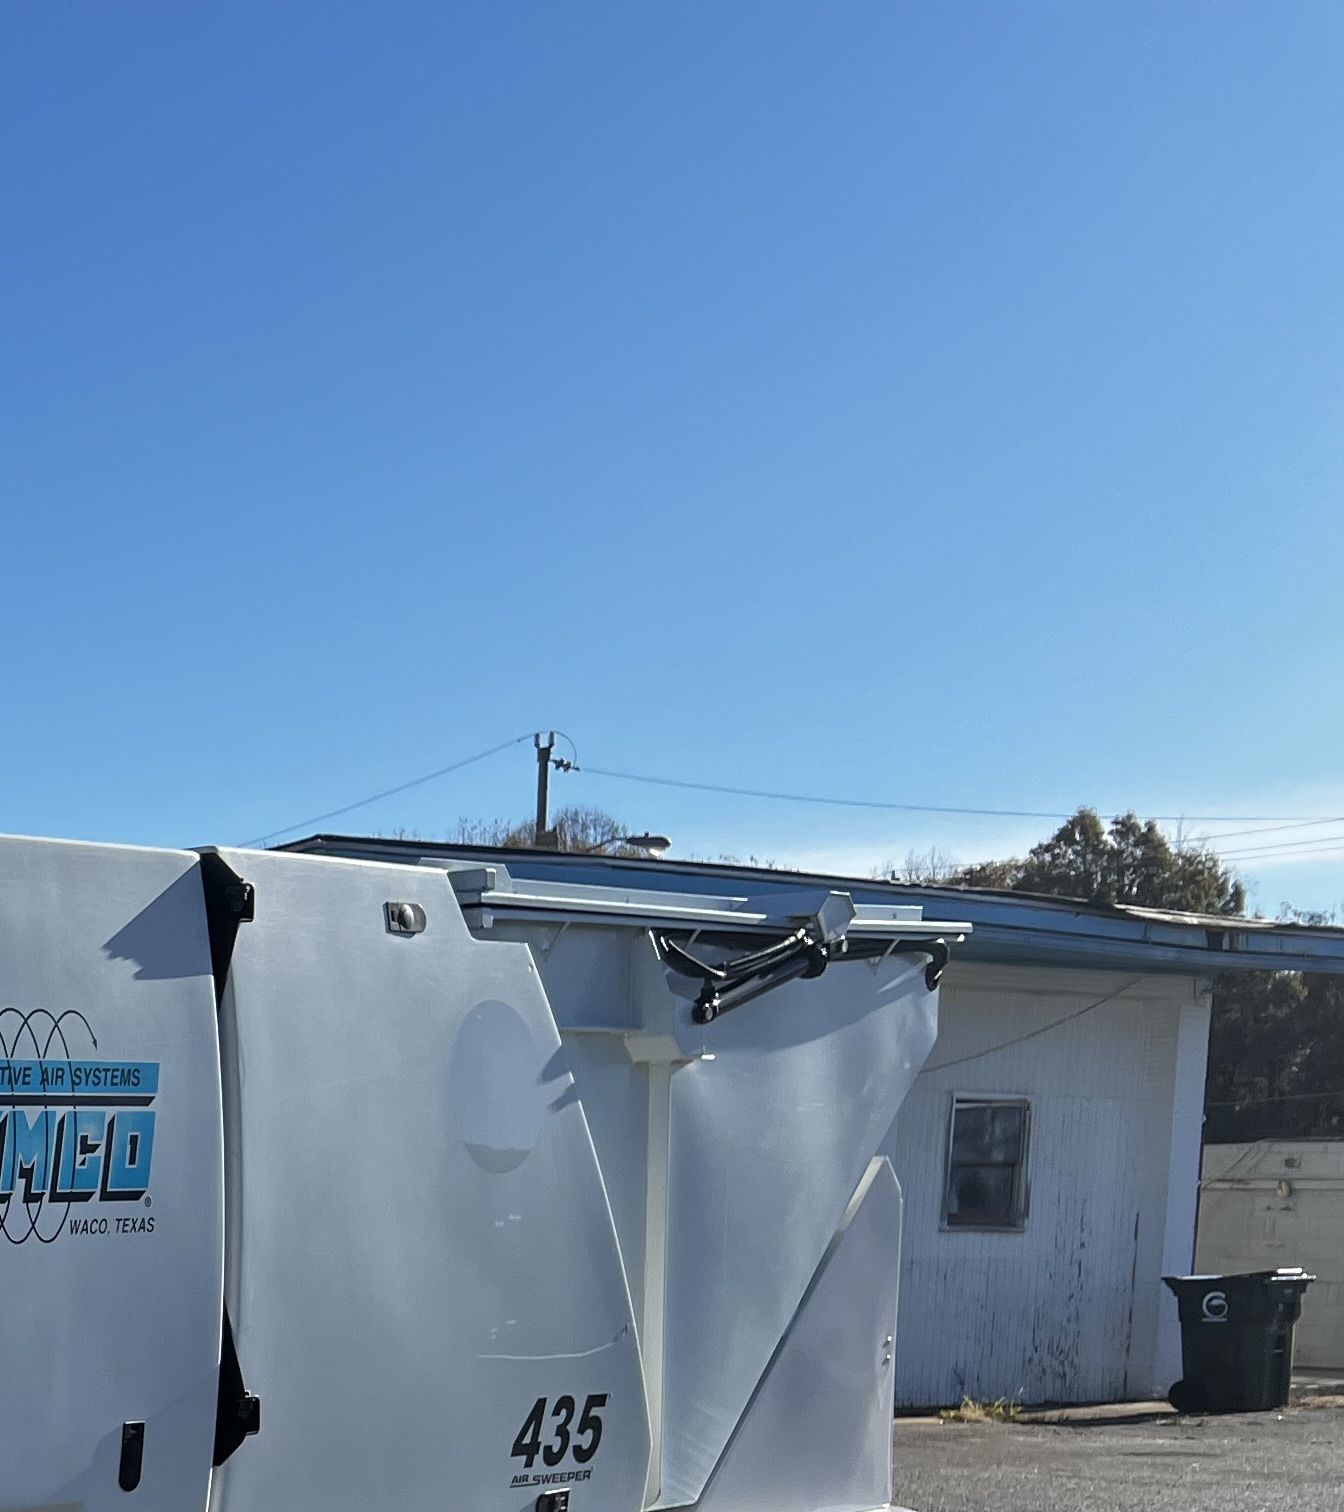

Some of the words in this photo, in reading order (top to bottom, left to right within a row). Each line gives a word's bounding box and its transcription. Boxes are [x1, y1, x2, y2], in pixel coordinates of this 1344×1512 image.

[40, 1066, 65, 1087] AIR
[73, 1067, 142, 1088] SYSTEMS
[116, 1217, 155, 1234] TEXAS
[510, 1393, 608, 1469] 435
[511, 1474, 530, 1485] AIR
[533, 1469, 592, 1486] SWEEPER
